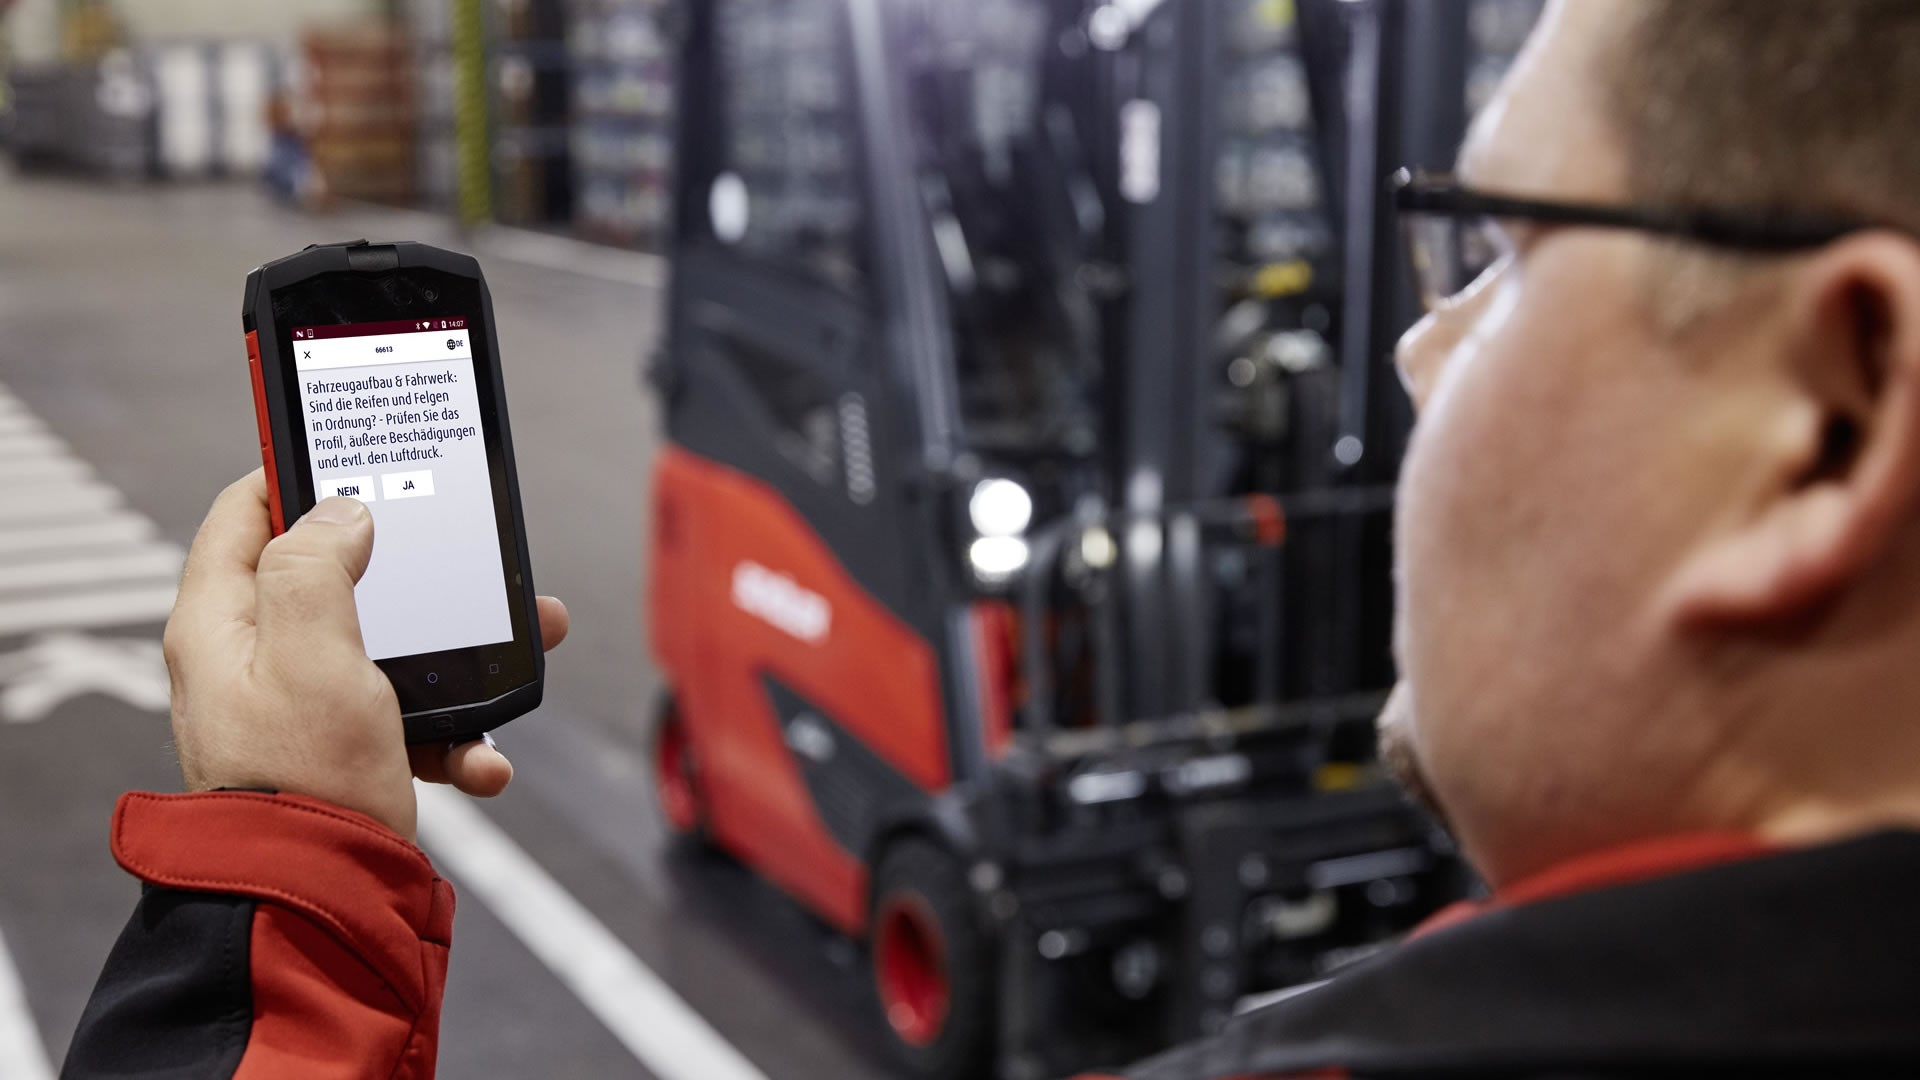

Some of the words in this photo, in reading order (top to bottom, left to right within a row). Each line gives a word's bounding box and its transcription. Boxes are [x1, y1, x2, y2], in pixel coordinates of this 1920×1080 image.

[375, 346, 393, 354] 66613
[307, 375, 393, 395] Fahrzeugaufbau
[395, 375, 403, 388] &
[405, 370, 458, 387] Fahrwerk:
[309, 399, 333, 413] Sind
[335, 397, 352, 411] die
[355, 395, 390, 409] Reifen
[392, 392, 412, 406] und
[414, 391, 449, 407] Felgen
[312, 419, 323, 432] in
[325, 414, 377, 431] Ordnung?
[386, 411, 421, 425] Prüfen
[423, 409, 439, 422] Sie
[441, 407, 460, 421] das
[315, 435, 347, 451] Profil,
[349, 432, 387, 448] äußere
[389, 426, 476, 444] Beschädigungen
[317, 456, 339, 469] und
[341, 453, 365, 467] evtl.
[367, 451, 388, 465] den
[390, 445, 443, 463] Luftdruck.
[337, 486, 360, 497] NEIN
[402, 480, 415, 491] JA
